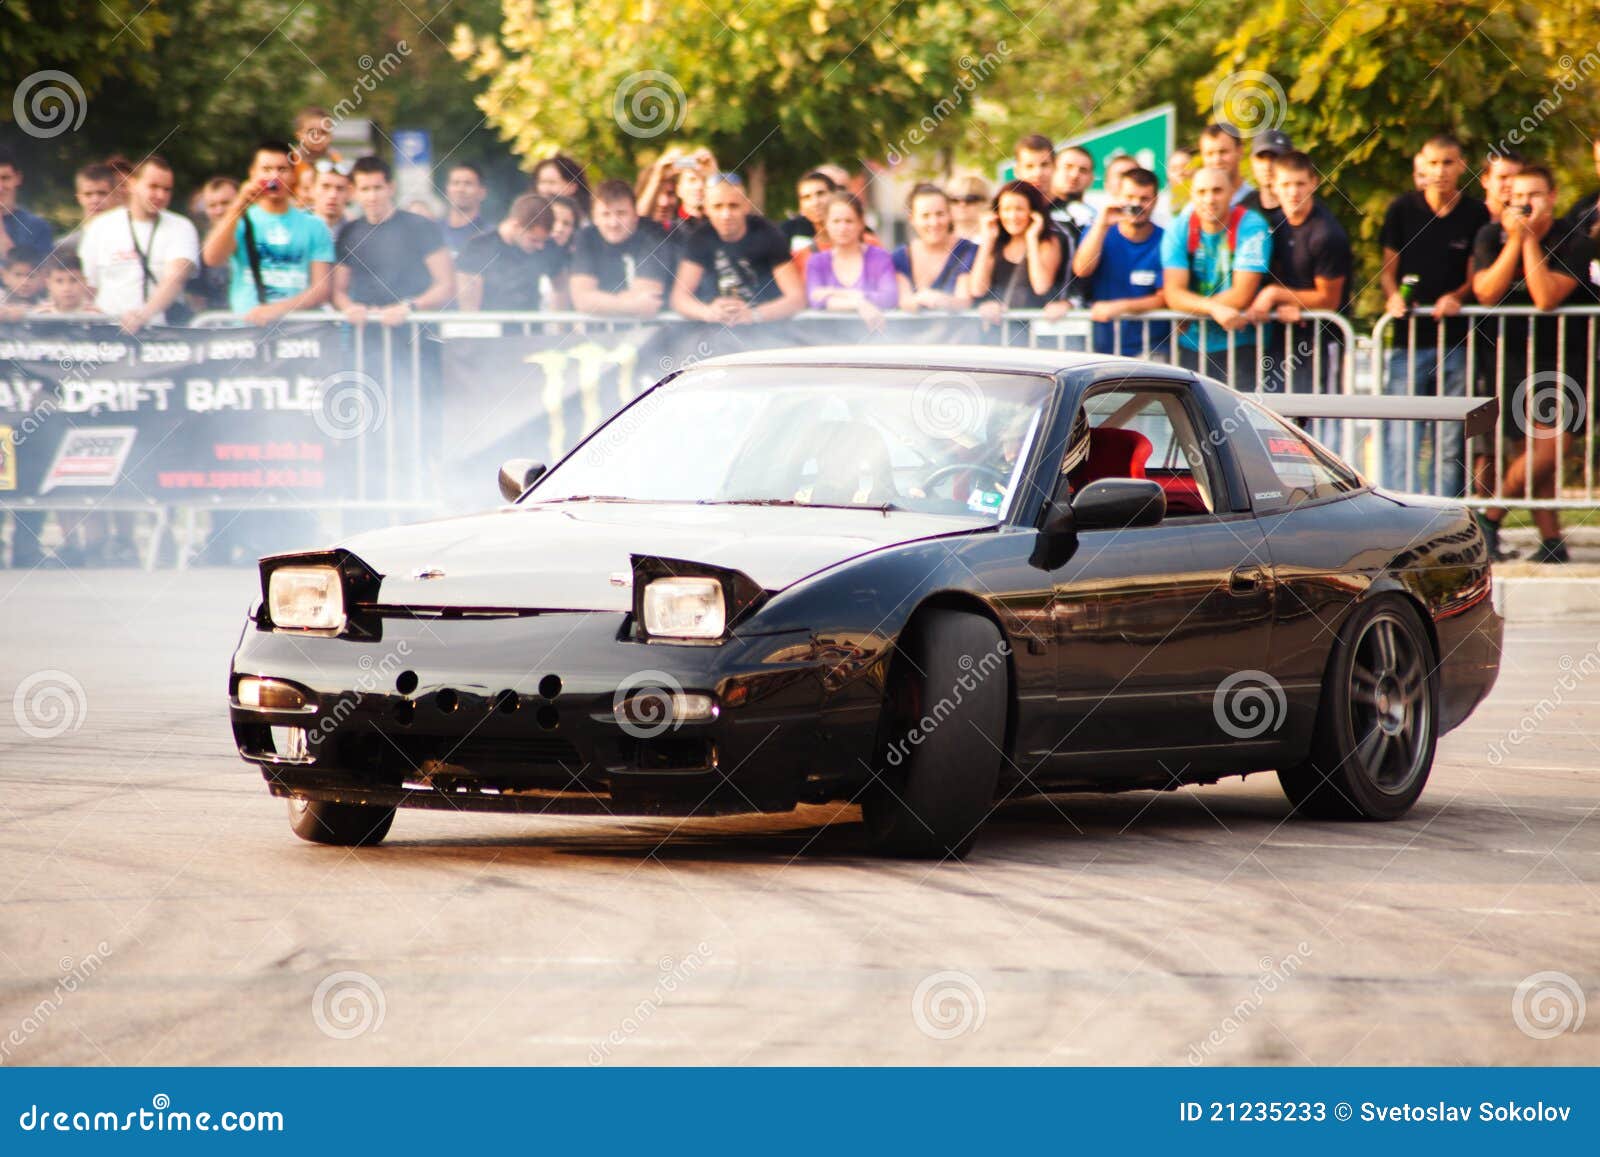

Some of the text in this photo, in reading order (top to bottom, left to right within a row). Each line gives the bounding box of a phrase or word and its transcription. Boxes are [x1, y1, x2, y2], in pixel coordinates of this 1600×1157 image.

[0, 338, 321, 362] AMPIONSHIP 2009 2010 2011
[64, 378, 175, 412] DRIFT
[186, 376, 324, 412] BATTLE
